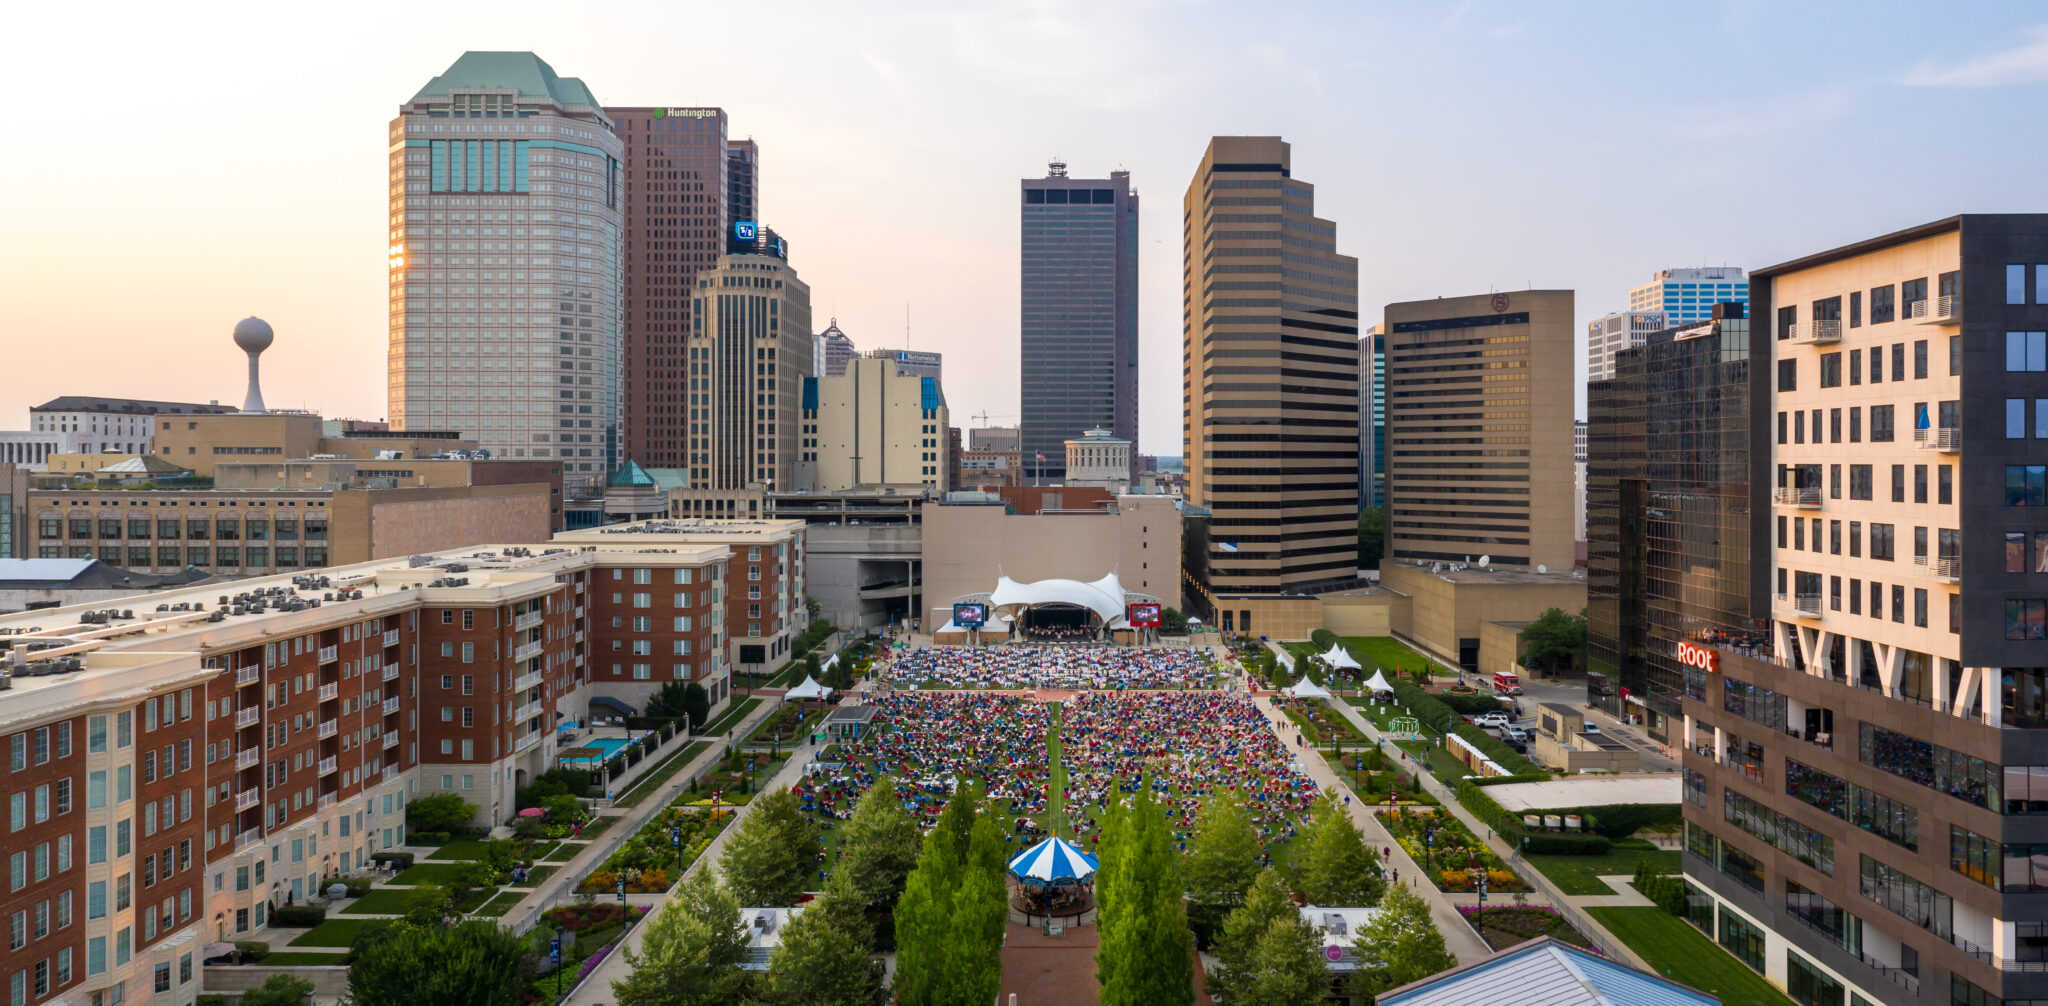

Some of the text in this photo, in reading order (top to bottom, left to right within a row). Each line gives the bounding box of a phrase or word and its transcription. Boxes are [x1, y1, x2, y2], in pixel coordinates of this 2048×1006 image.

[667, 107, 717, 120] Huntington
[1643, 315, 1660, 323] PNC
[907, 353, 937, 362] Nationwide
[1677, 641, 1713, 673] Root
